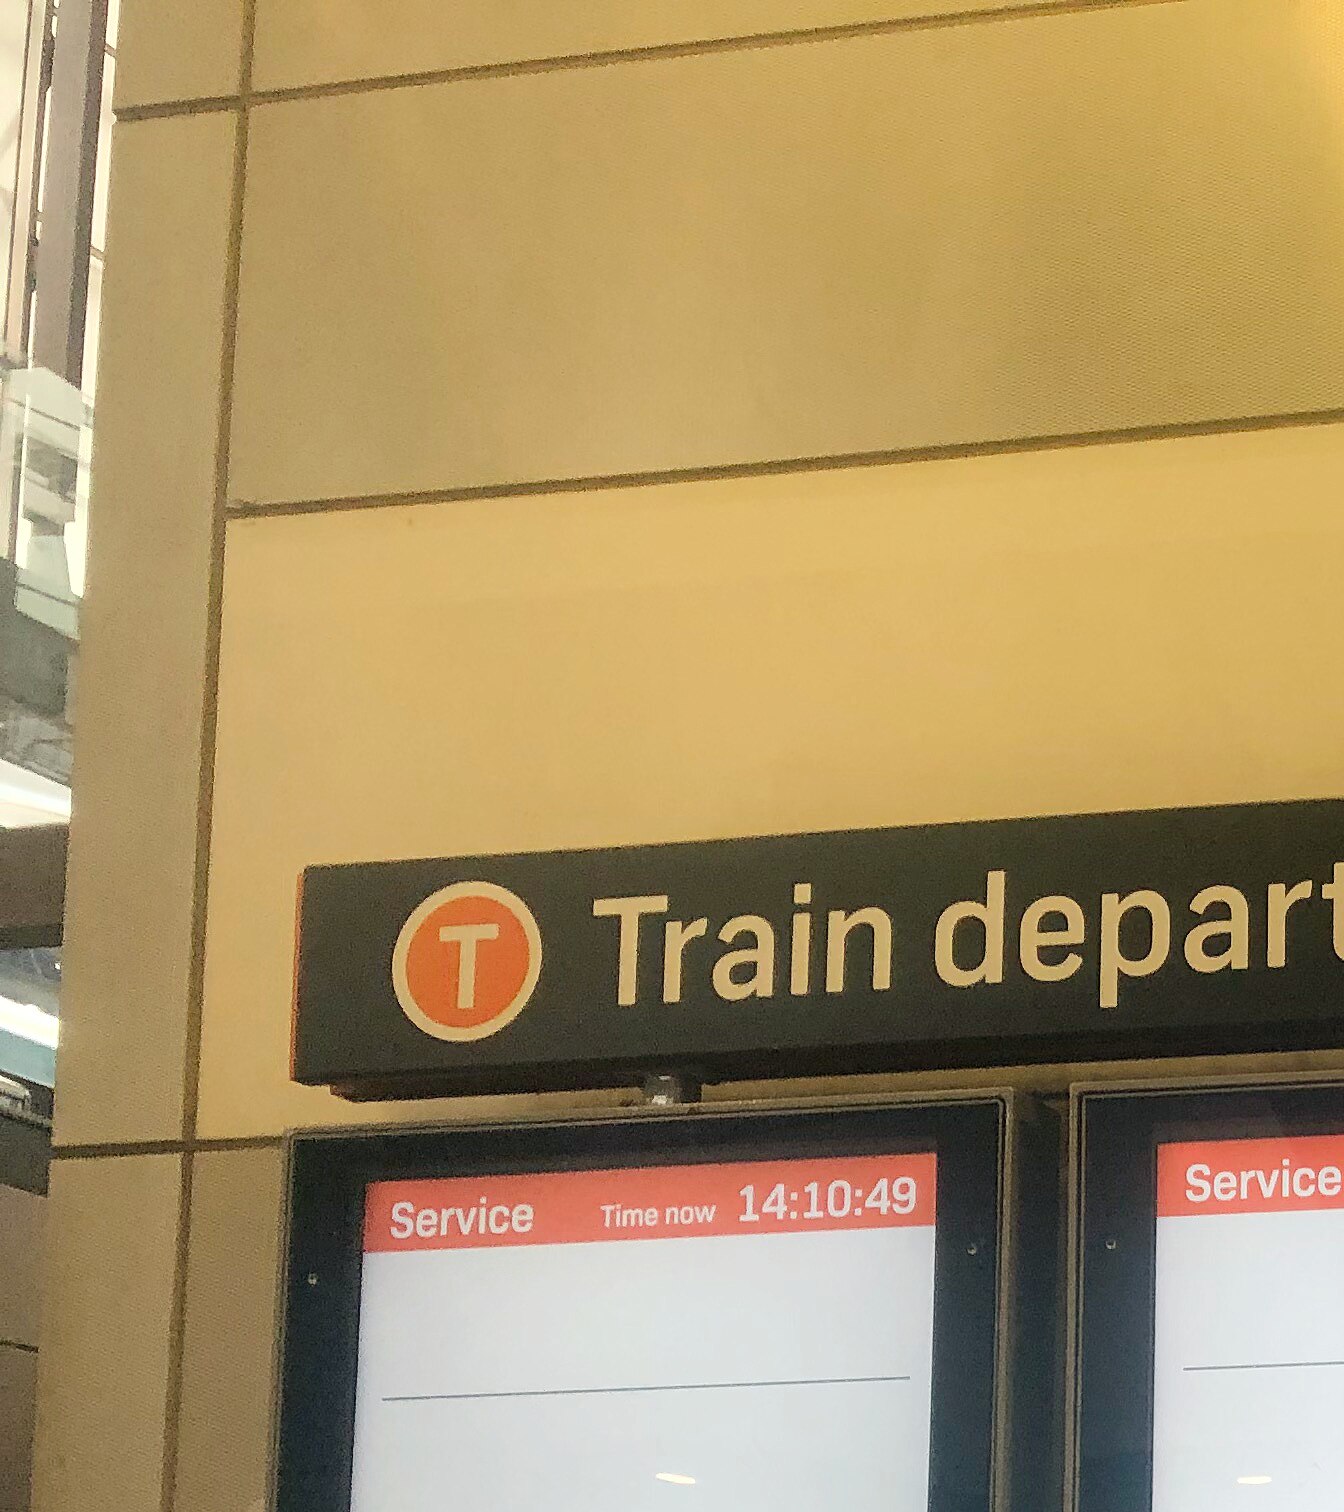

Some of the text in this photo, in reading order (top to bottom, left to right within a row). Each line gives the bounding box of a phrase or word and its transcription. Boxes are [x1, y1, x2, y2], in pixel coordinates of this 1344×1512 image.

[436, 921, 501, 1010] T
[592, 882, 893, 1007] Train
[600, 1176, 917, 1228] Time now 14:10:49
[1185, 1158, 1342, 1203] Service
[390, 1196, 534, 1239] Service
